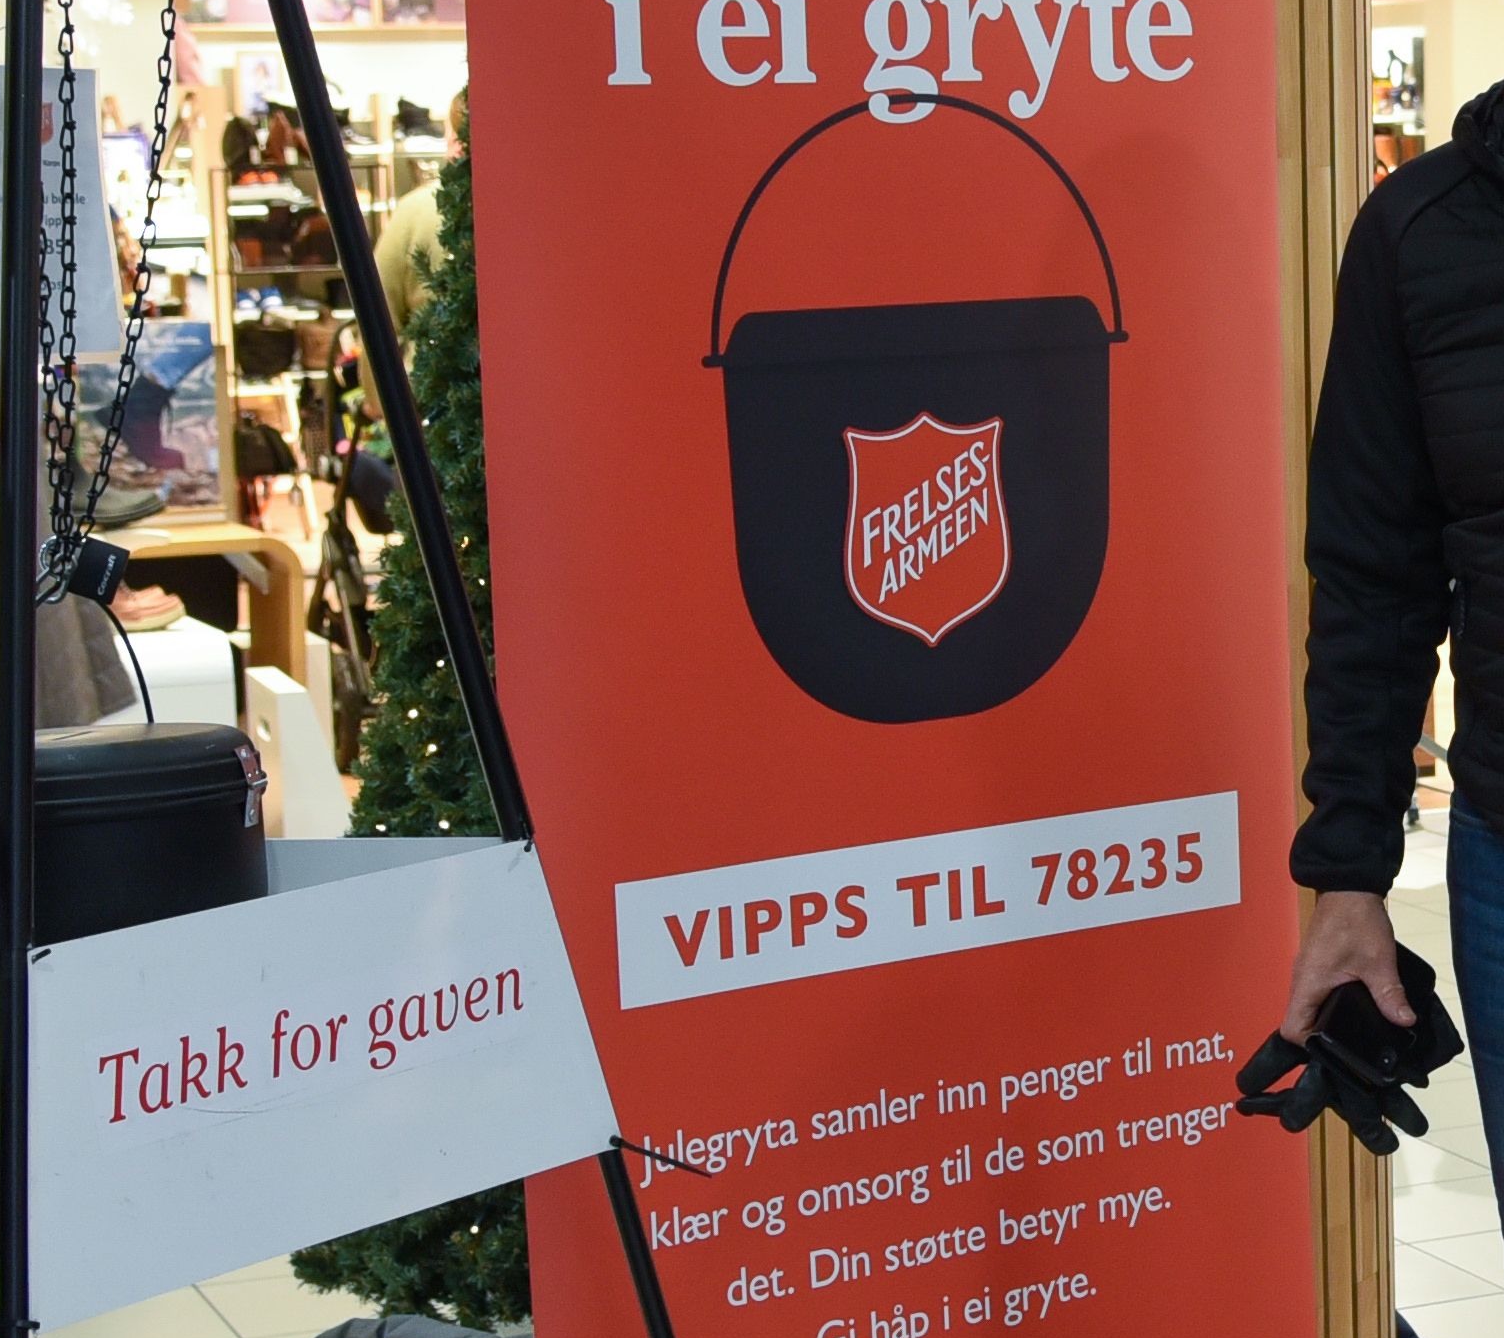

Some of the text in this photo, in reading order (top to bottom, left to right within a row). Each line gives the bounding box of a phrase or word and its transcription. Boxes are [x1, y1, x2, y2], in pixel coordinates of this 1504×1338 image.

[862, 441, 990, 568] FRELSES-
[878, 487, 989, 604] ARMEEN
[665, 833, 1203, 966] VIPPS TIL 78235
[99, 969, 521, 1122] Takk for gaven
[639, 1032, 1234, 1189] Julegryta samler inn penger til mat,
[650, 1102, 1234, 1250] klær og omsorg til de som trenger
[727, 1186, 1171, 1307] det. Din støtte betyr mye.
[943, 1296, 950, 1330] i
[964, 1286, 991, 1324] ei
[1004, 1273, 1097, 1326] gryte.
